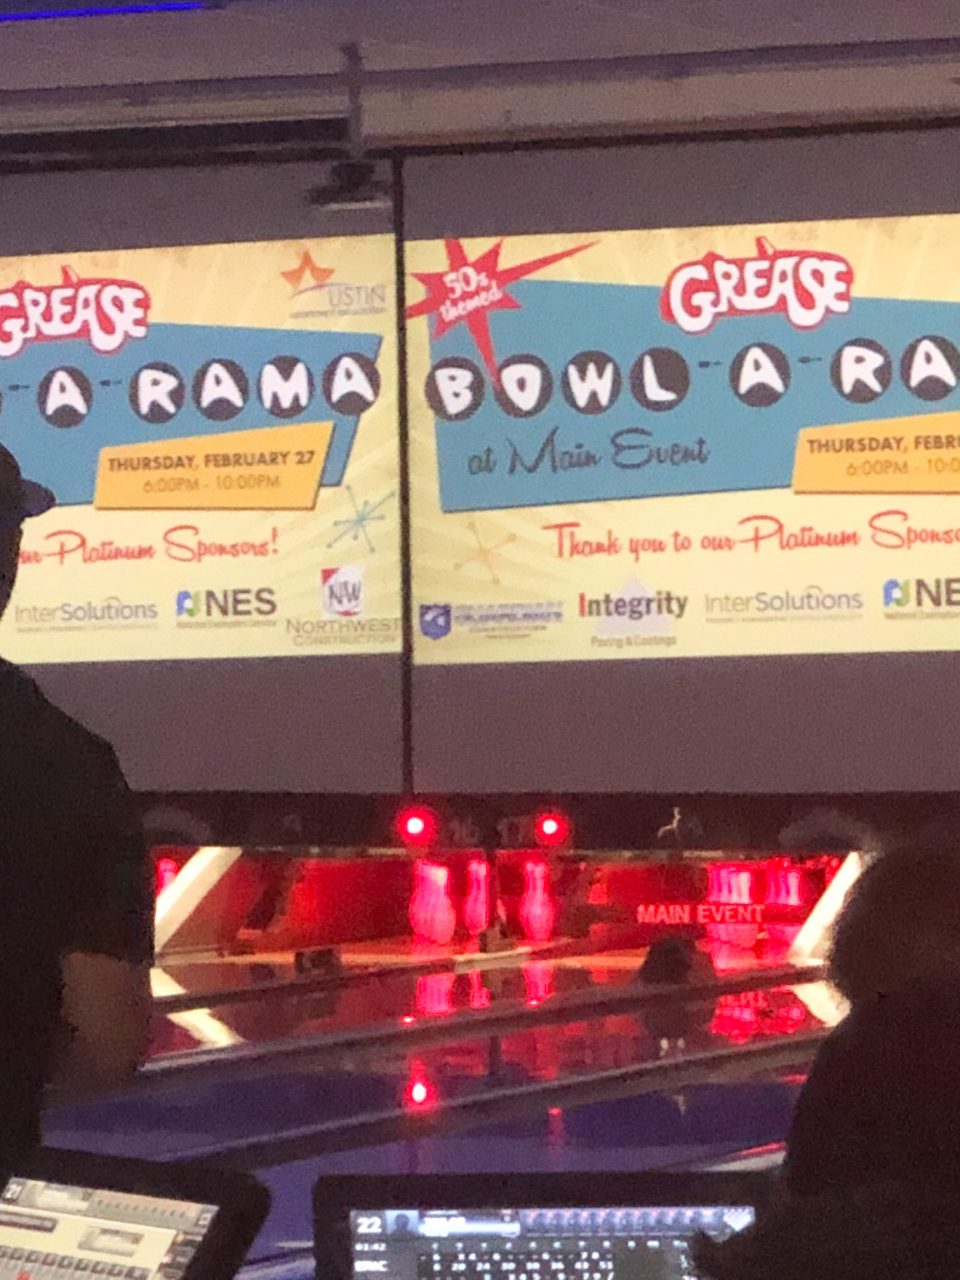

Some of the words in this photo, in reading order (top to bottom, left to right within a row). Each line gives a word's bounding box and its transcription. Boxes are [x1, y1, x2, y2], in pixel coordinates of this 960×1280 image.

[443, 267, 489, 298] 50s
[670, 256, 849, 332] GREASE
[440, 283, 503, 322] themed
[468, 446, 497, 475] at
[506, 426, 600, 475] Main
[610, 427, 709, 469] Event
[806, 437, 908, 454] THURSDAY,
[914, 435, 960, 450] FEBR
[108, 457, 197, 471] THURSDAY,
[204, 453, 288, 467] FEBRUARY
[295, 450, 315, 465] 27
[847, 460, 908, 477] 6:00PM
[143, 477, 200, 493] 6:00PM
[216, 474, 281, 489] 10:00PM
[45, 530, 155, 566] Platinum
[163, 525, 279, 563] Sponsors!
[542, 522, 621, 558] Thank
[629, 539, 667, 562] you
[673, 530, 692, 552] to
[701, 535, 735, 551] our
[738, 514, 861, 552] Platinum
[15, 596, 158, 622] InterSolutions
[205, 588, 277, 617] NES
[579, 590, 688, 620] Integrity
[704, 585, 863, 613] InterSolutions
[286, 618, 399, 635] NORTHWEST
[637, 904, 690, 923] MAIN
[697, 904, 766, 923] EVENT
[357, 1217, 382, 1233] 22
